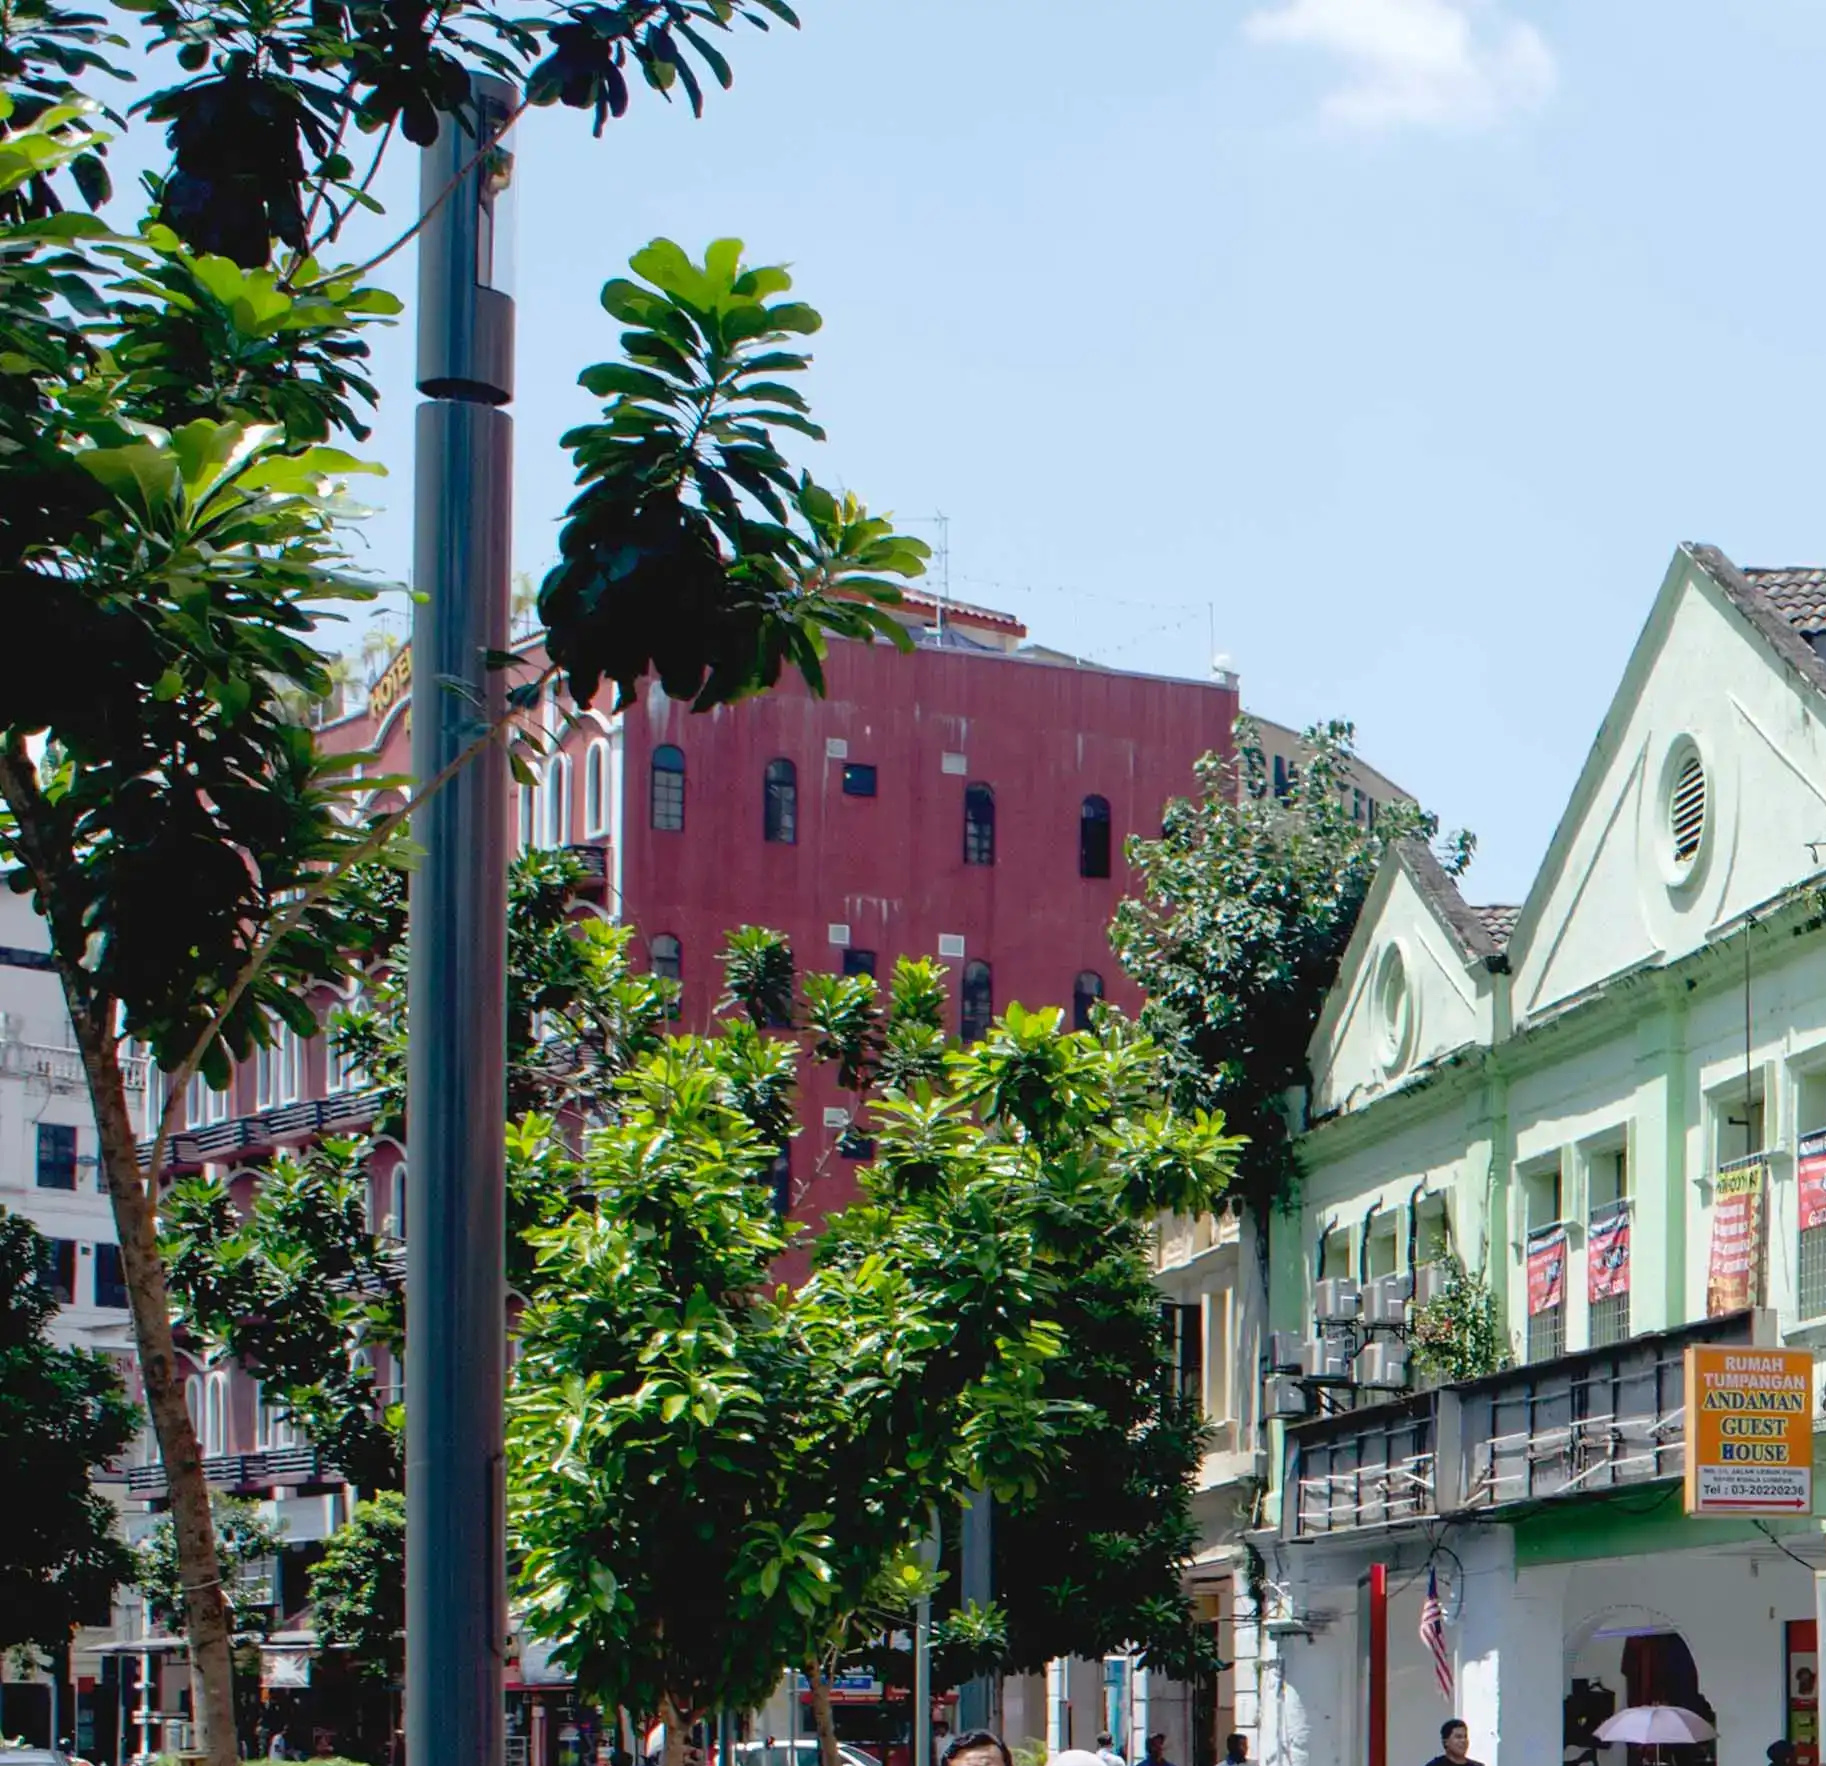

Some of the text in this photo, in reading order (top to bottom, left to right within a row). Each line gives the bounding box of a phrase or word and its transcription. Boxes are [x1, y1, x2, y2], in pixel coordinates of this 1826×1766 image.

[1725, 1356, 1784, 1372] RUMAH
[1704, 1373, 1806, 1390] TUMPANGAN
[1703, 1390, 1805, 1412] ANDAMAN
[1721, 1417, 1788, 1437] GUEST
[1721, 1443, 1788, 1464] HOUSE
